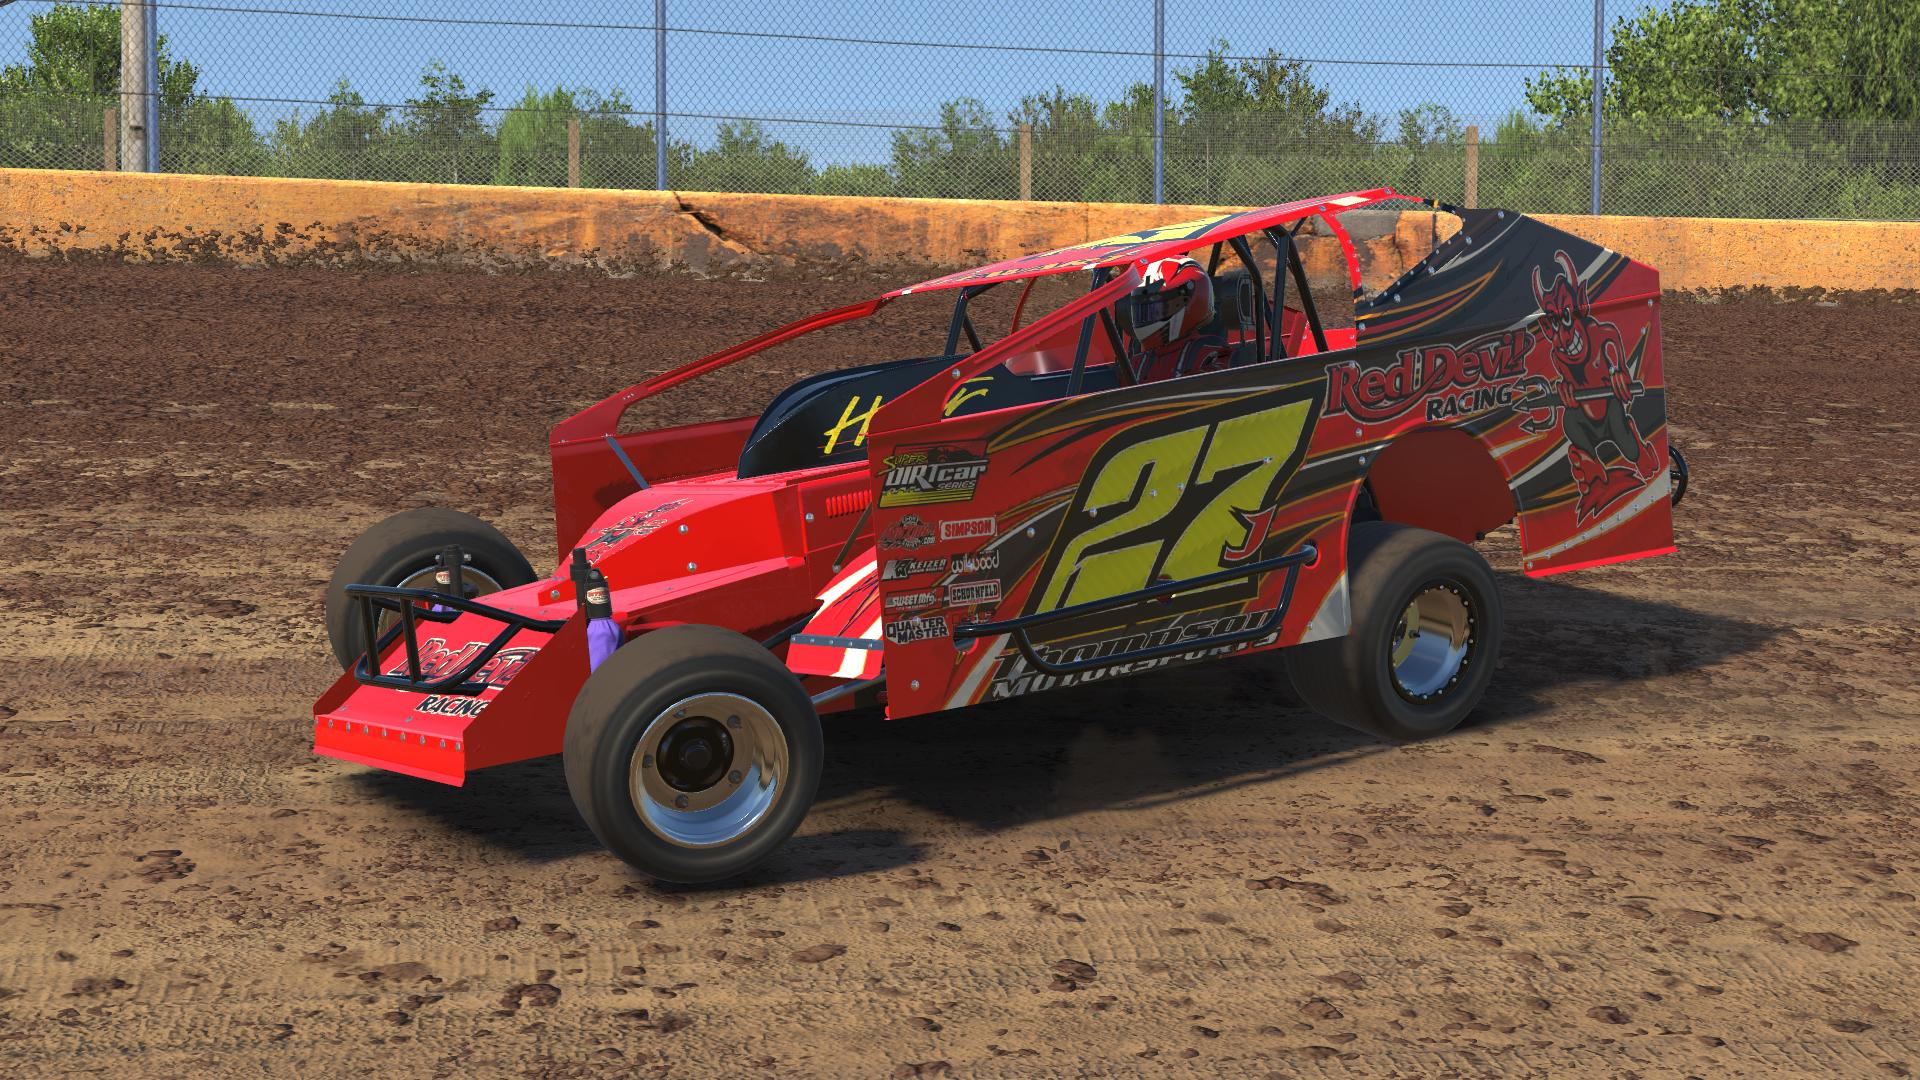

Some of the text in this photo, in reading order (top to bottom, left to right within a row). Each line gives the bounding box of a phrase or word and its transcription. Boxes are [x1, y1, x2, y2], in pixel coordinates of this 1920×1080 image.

[1321, 349, 1420, 424] Red
[1426, 383, 1514, 421] RACING
[936, 480, 977, 491] SERIES
[1035, 398, 1313, 613] 27
[943, 520, 993, 538] SIMPSON
[909, 559, 948, 570] KEIZER
[951, 584, 998, 602] SCHOENFELD
[886, 617, 945, 638] QUARTER
[897, 626, 948, 644] MASTER
[415, 695, 491, 719] RACING
